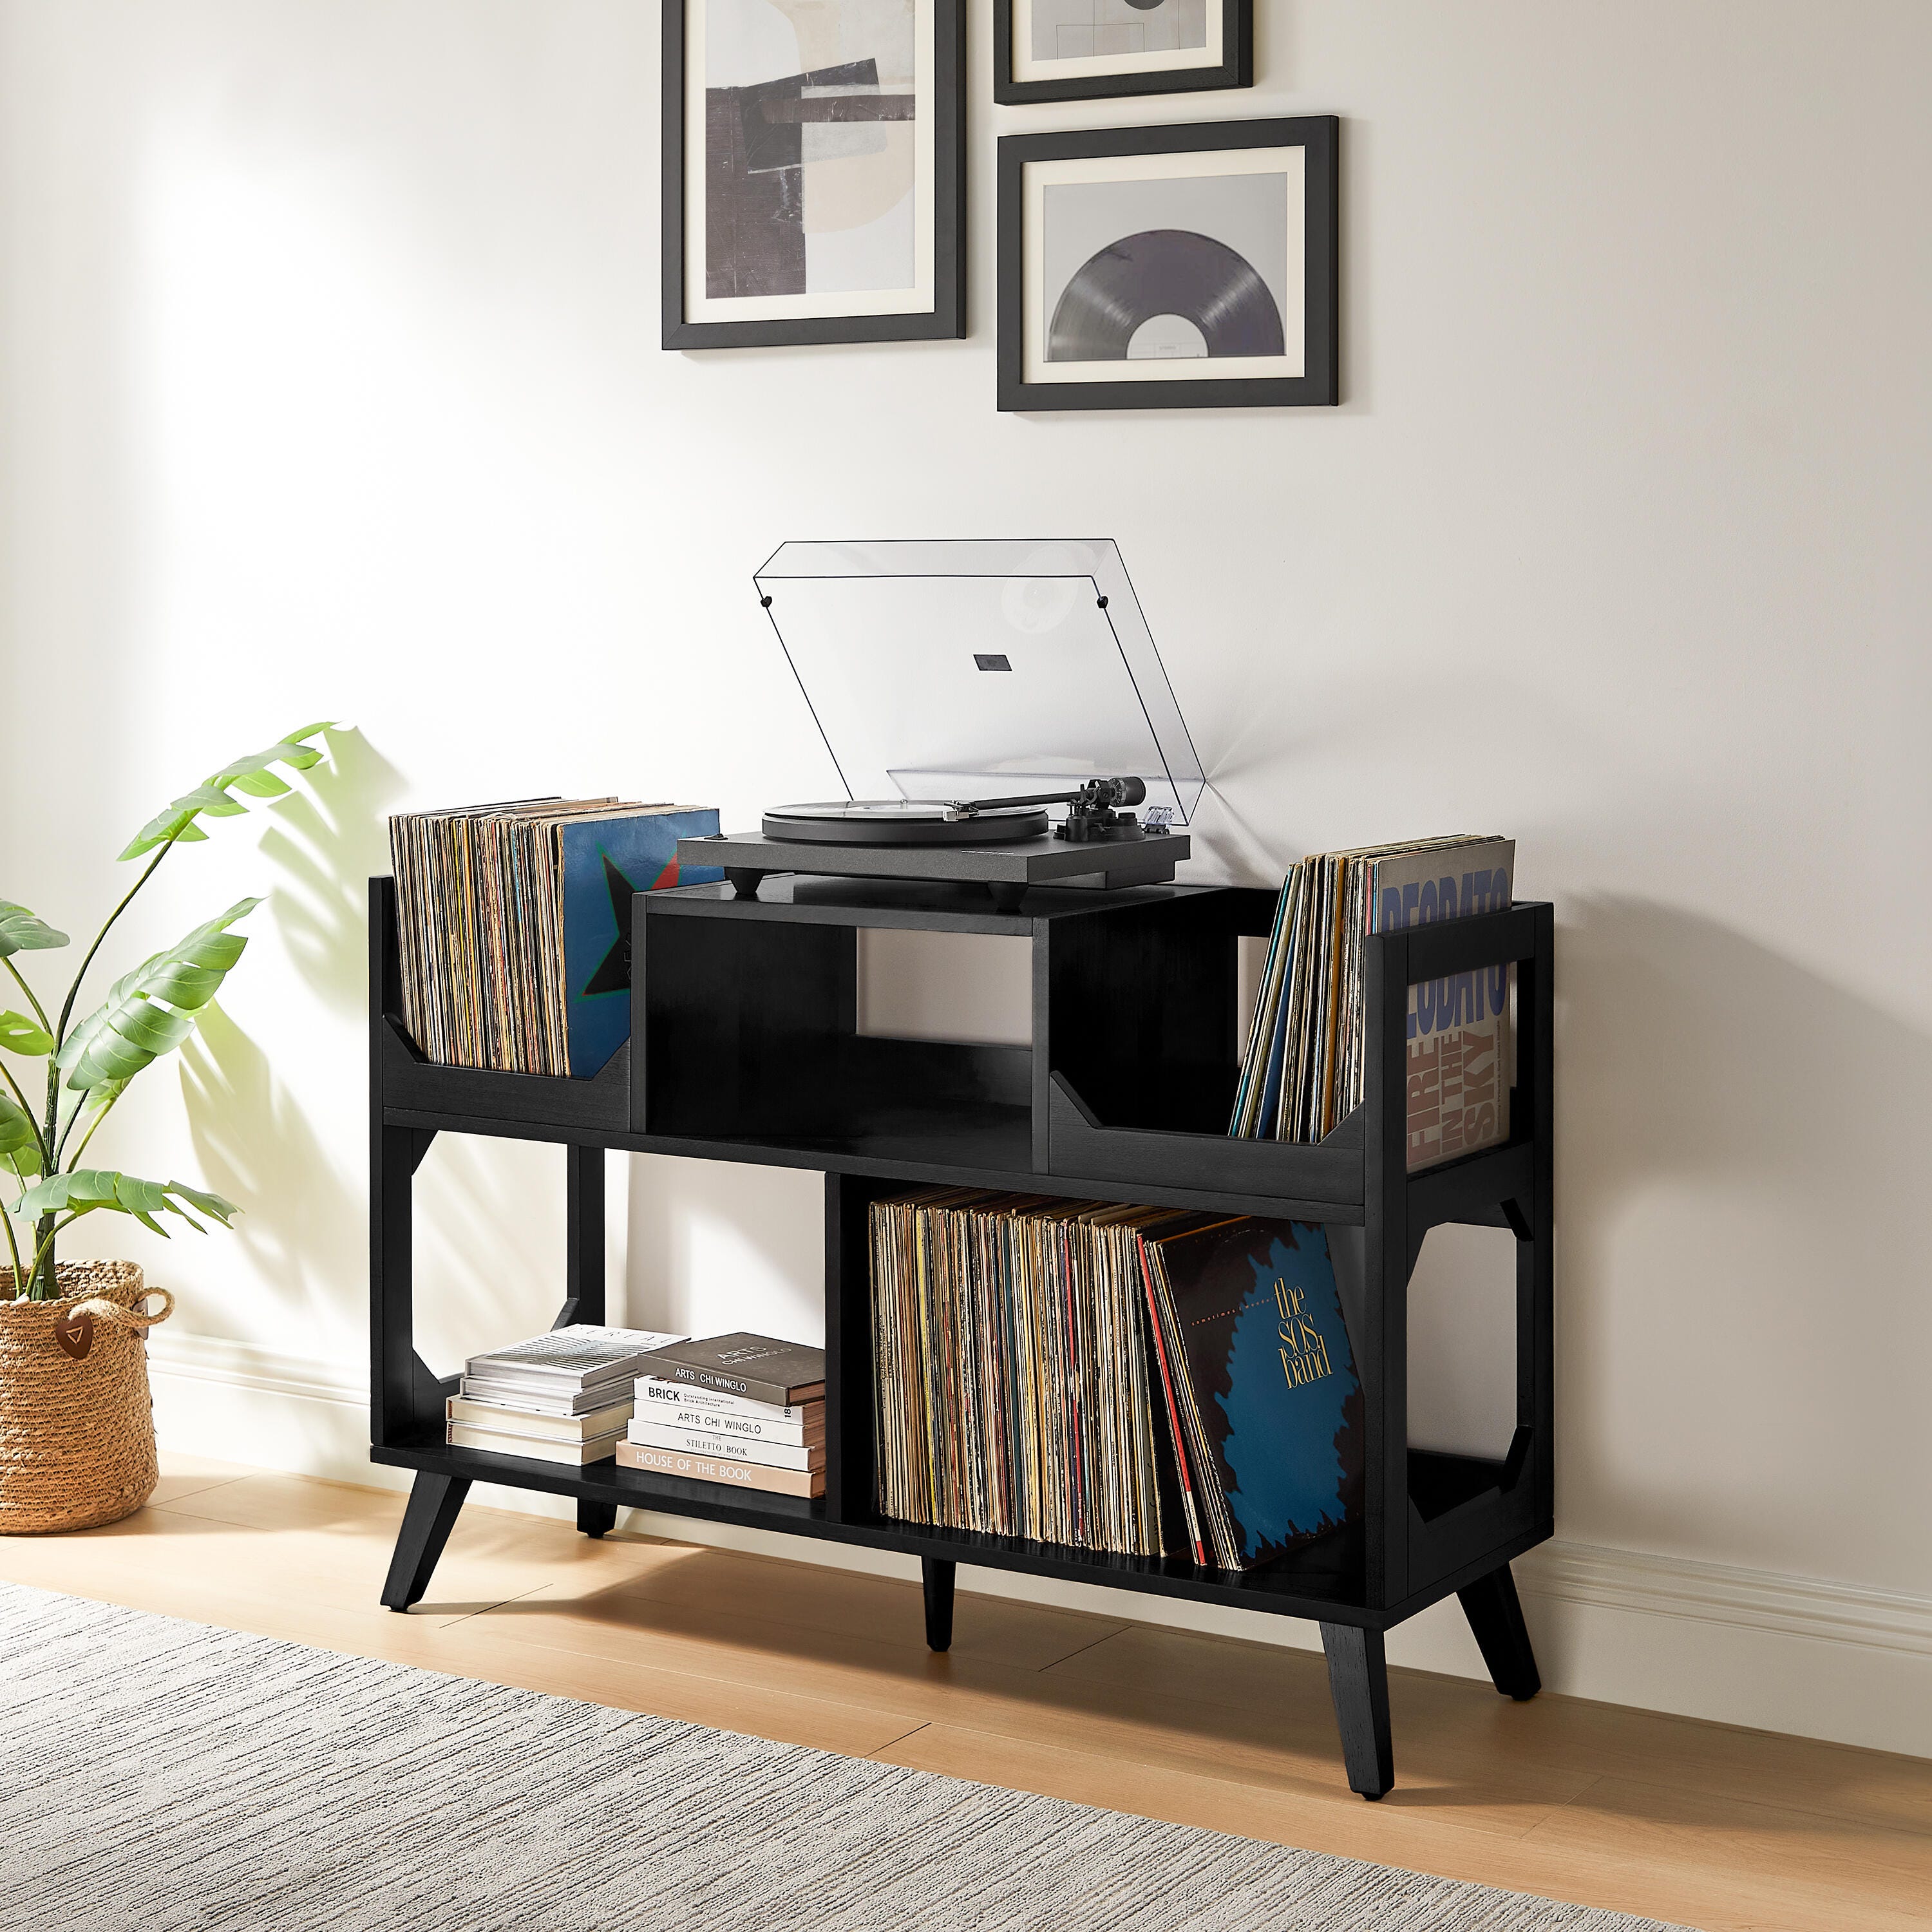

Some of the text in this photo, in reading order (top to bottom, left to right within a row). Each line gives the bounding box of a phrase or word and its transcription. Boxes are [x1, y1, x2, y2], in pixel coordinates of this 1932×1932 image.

[1381, 867, 1509, 1038] EODATO
[1407, 1037, 1440, 1166] FIRE
[1441, 1030, 1463, 1153] IN THE
[1463, 1030, 1495, 1146] SKY
[1273, 1277, 1307, 1320] the
[717, 1346, 767, 1359] ARTS
[1278, 1334, 1333, 1390] band
[649, 1387, 680, 1401] BRICK
[676, 1367, 747, 1392] ARTS CHI WINGLO
[677, 1412, 761, 1434] ARTS CHI WINGLO
[784, 1408, 791, 1418] 18
[686, 1439, 722, 1452] STILETTO
[726, 1445, 748, 1456] BOOK
[636, 1452, 673, 1468] HOUSE
[677, 1457, 692, 1472] OF
[696, 1461, 715, 1476] THE
[719, 1464, 752, 1482] BOOK
